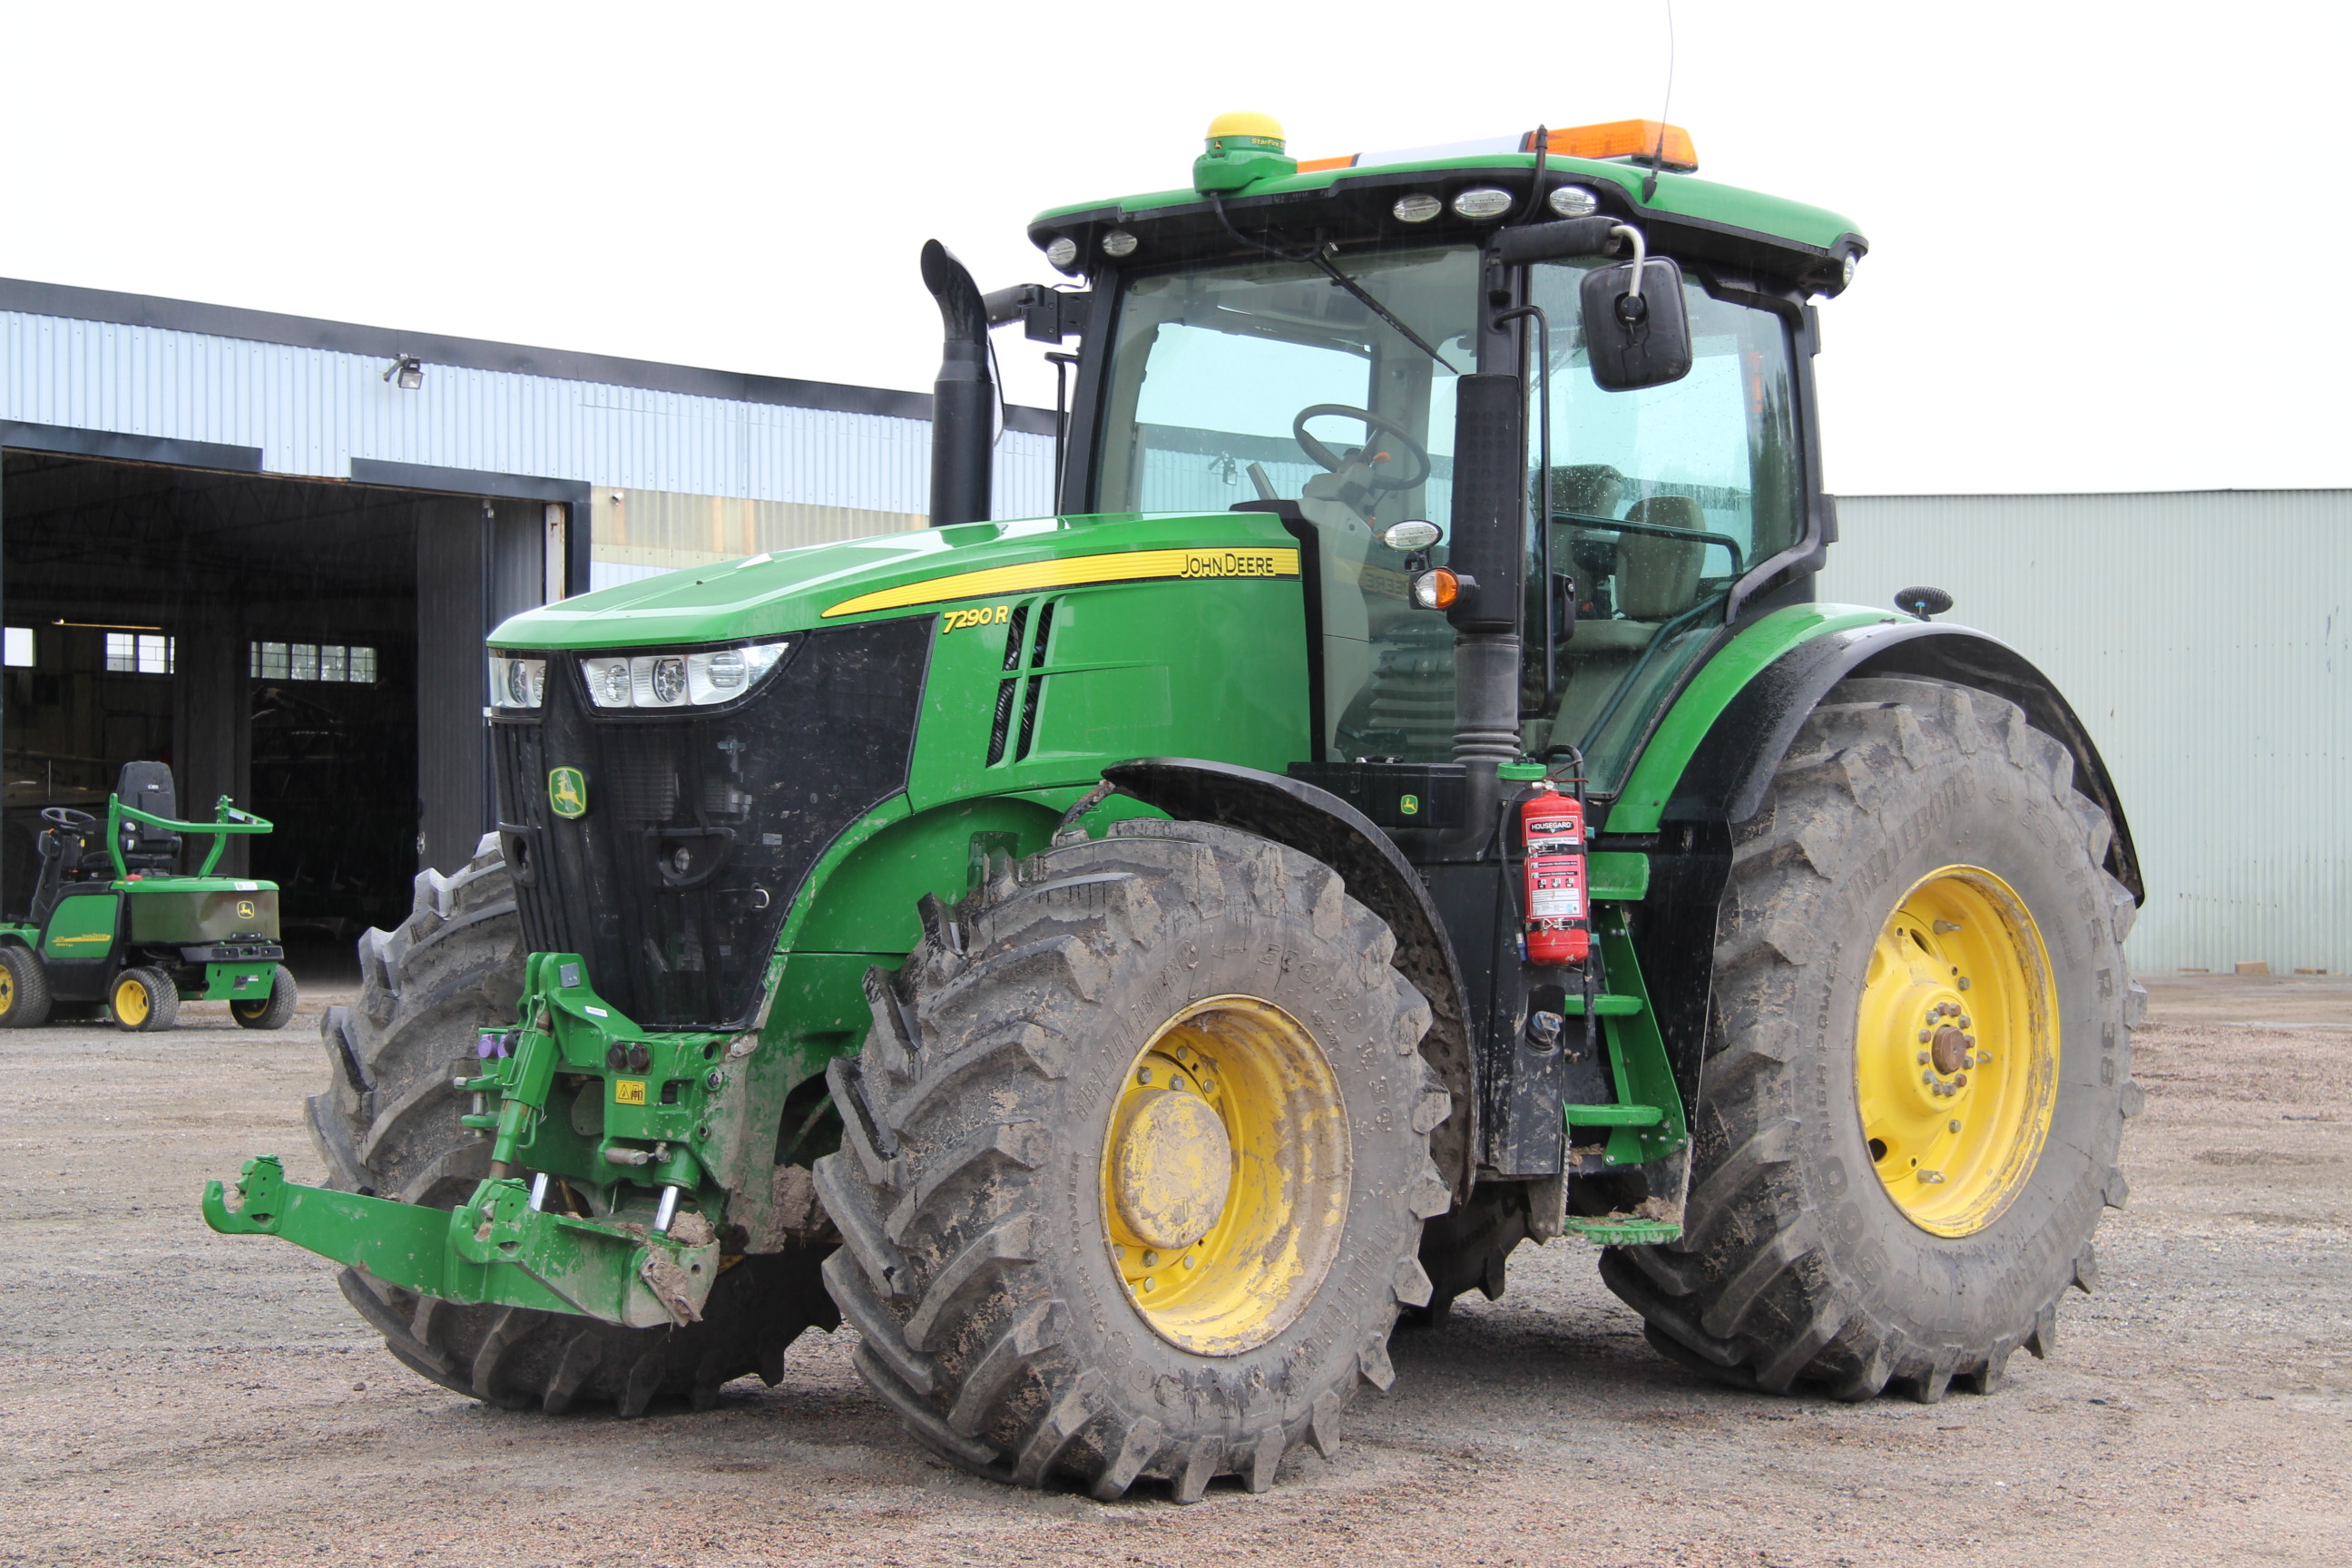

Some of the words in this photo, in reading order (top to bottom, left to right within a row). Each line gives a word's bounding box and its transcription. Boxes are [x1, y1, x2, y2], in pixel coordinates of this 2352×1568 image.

[1181, 554, 1222, 574] JOHN
[1225, 554, 1274, 573] DEERE
[943, 607, 993, 633] 7290
[1531, 821, 1571, 830] HOUSEGARD
